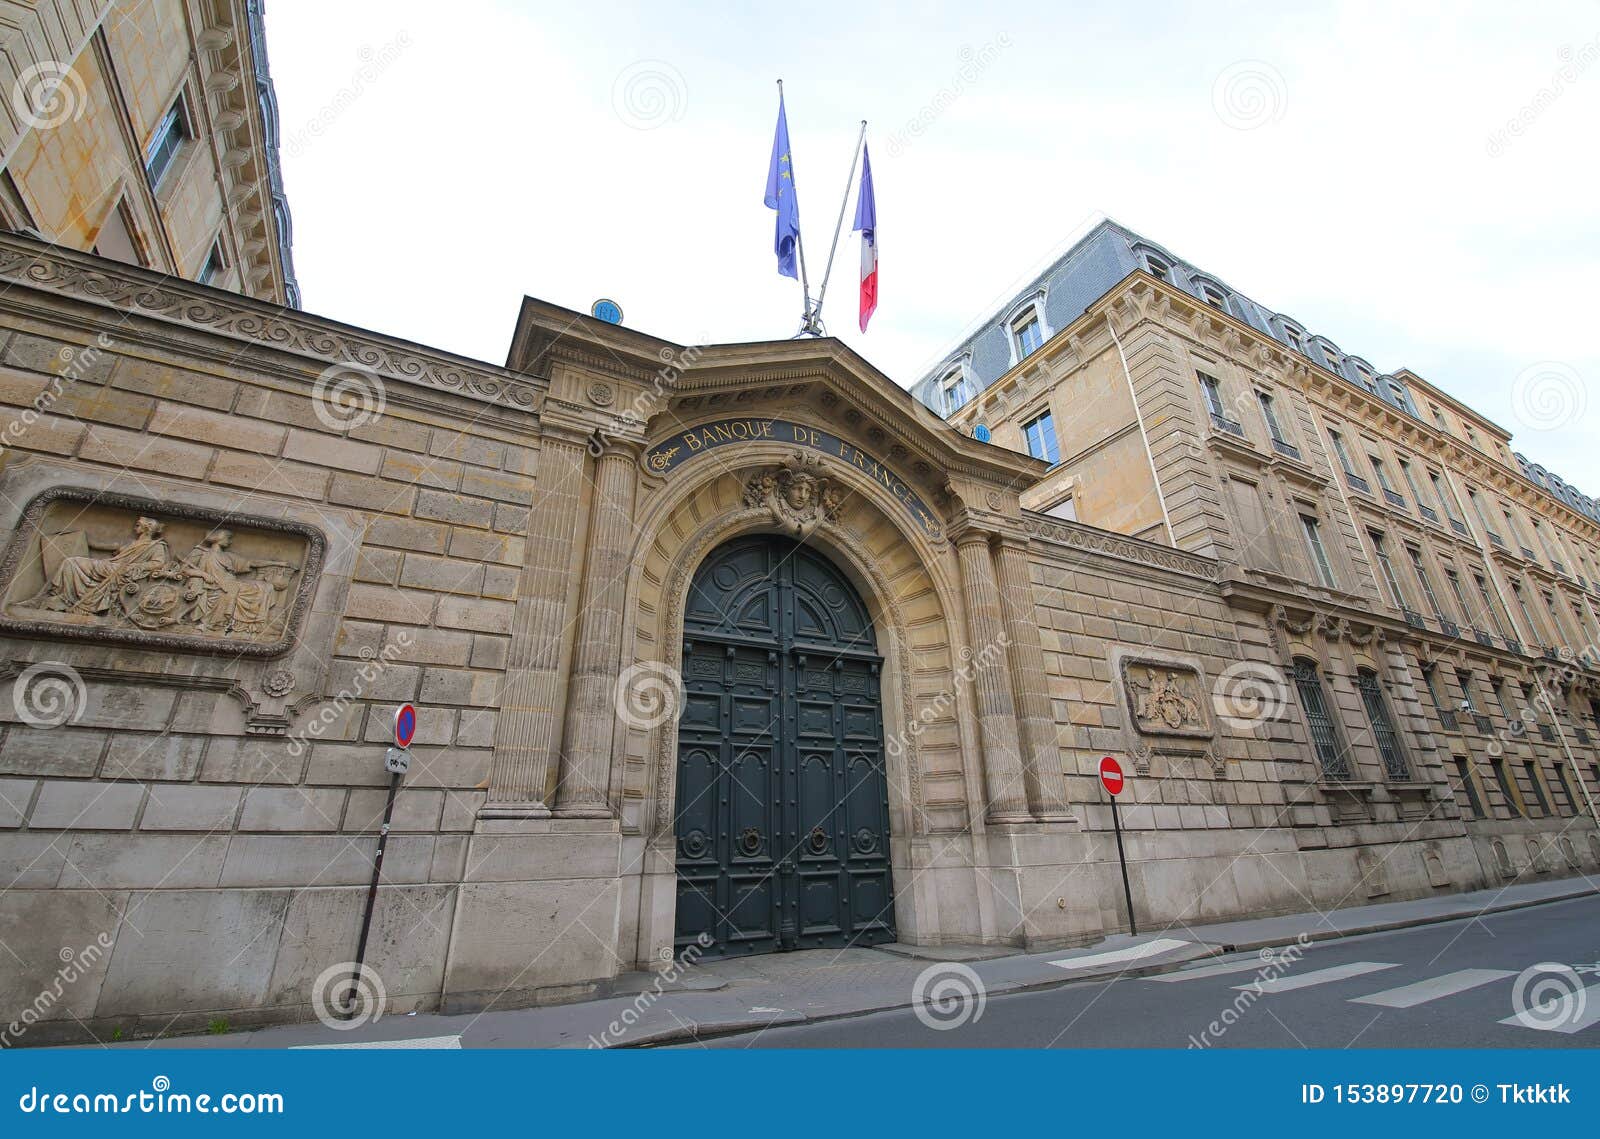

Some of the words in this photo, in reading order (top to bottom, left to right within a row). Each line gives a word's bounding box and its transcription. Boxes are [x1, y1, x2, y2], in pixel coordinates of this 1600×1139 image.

[683, 421, 775, 452] BANQUE
[793, 425, 821, 446] DE
[840, 442, 916, 507] FRANCE
